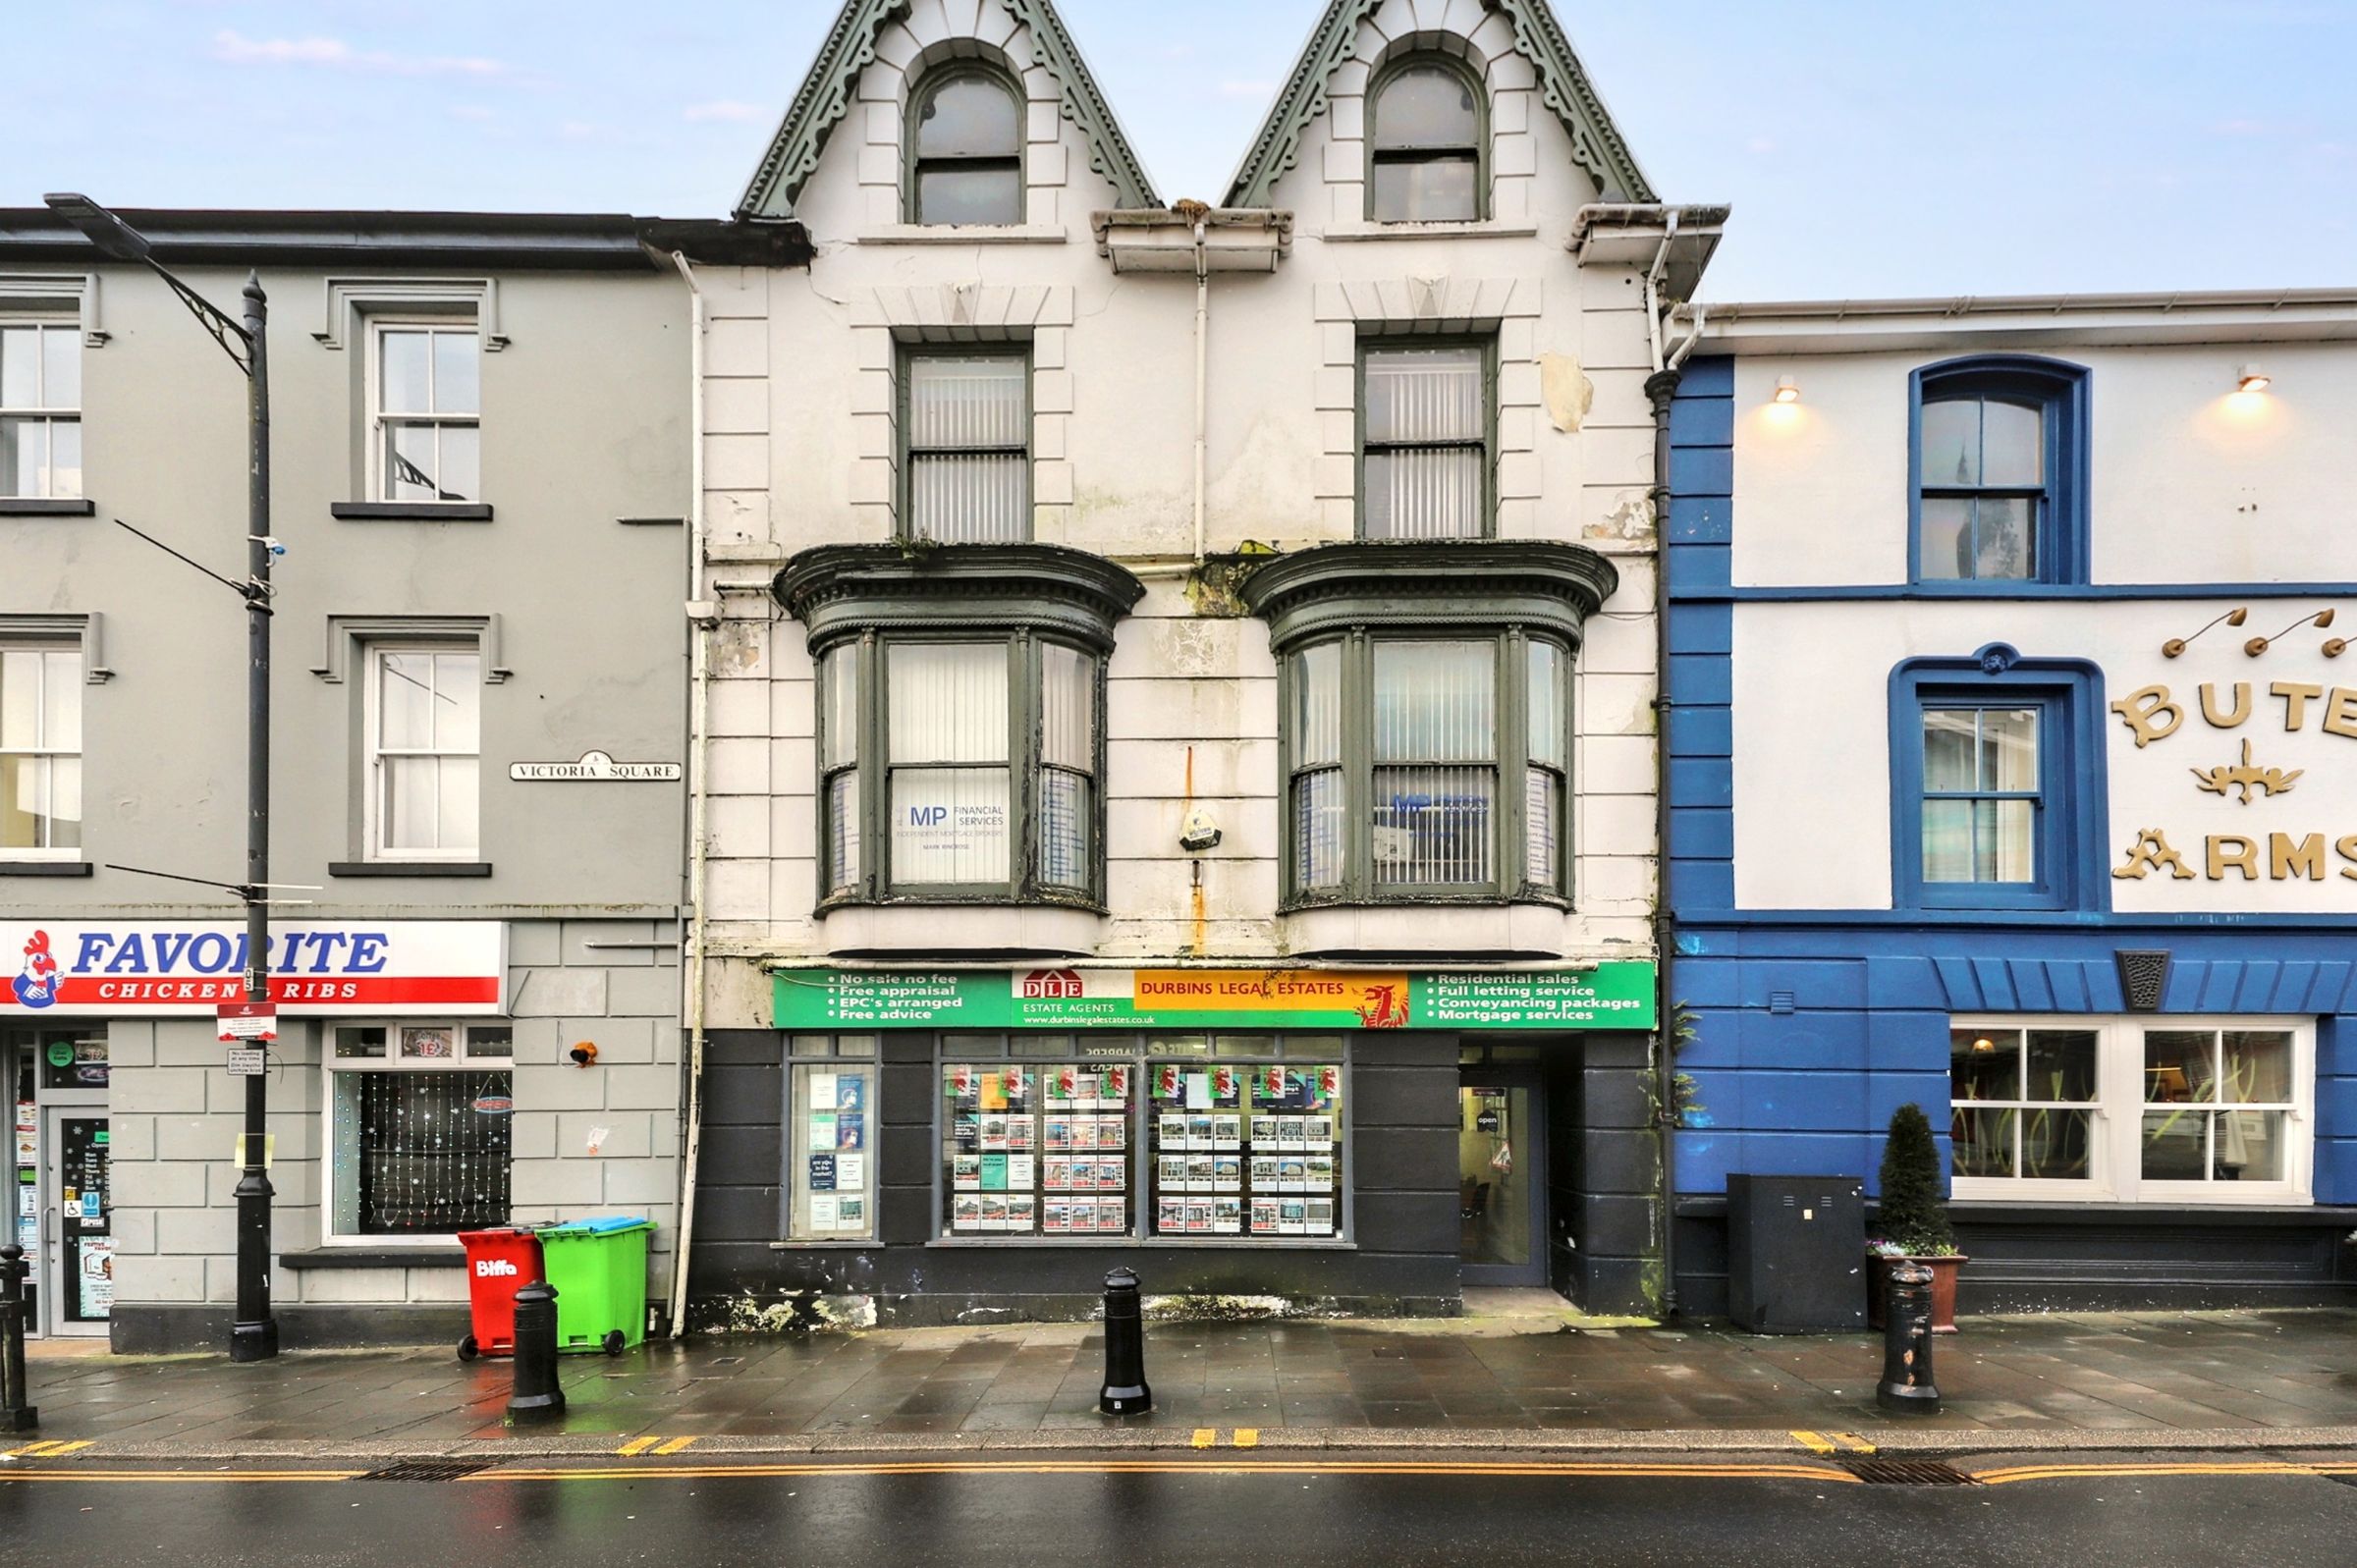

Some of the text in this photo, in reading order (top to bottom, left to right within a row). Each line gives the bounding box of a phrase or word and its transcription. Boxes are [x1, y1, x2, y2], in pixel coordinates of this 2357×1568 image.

[2111, 681, 2357, 749] BUTE
[520, 765, 674, 779] VICTORIA SQUARE
[909, 806, 1004, 827] MP FINANCIAL
[959, 816, 1004, 826] SERVICES
[840, 974, 958, 985] No sale no fee
[1439, 974, 1579, 985] Residential sales
[99, 983, 240, 999] CHICKEN
[283, 983, 357, 999] RIBS
[840, 985, 956, 998] Free appraisal
[1025, 982, 1081, 997] DLE
[1141, 982, 1344, 996] DURBINS LEGAL ESTATES
[1439, 986, 1596, 998] Full letting service
[840, 998, 963, 1010] EPC's arranged
[1023, 1003, 1115, 1013] ESTATE AGENTS
[1439, 997, 1641, 1010] Conveyancing packages
[840, 1008, 933, 1020] Free advice
[1438, 1009, 1594, 1021] Mortgage services
[1023, 1015, 1156, 1026] www.durbinslegalestates.co.uk
[476, 1260, 518, 1277] Biffa
